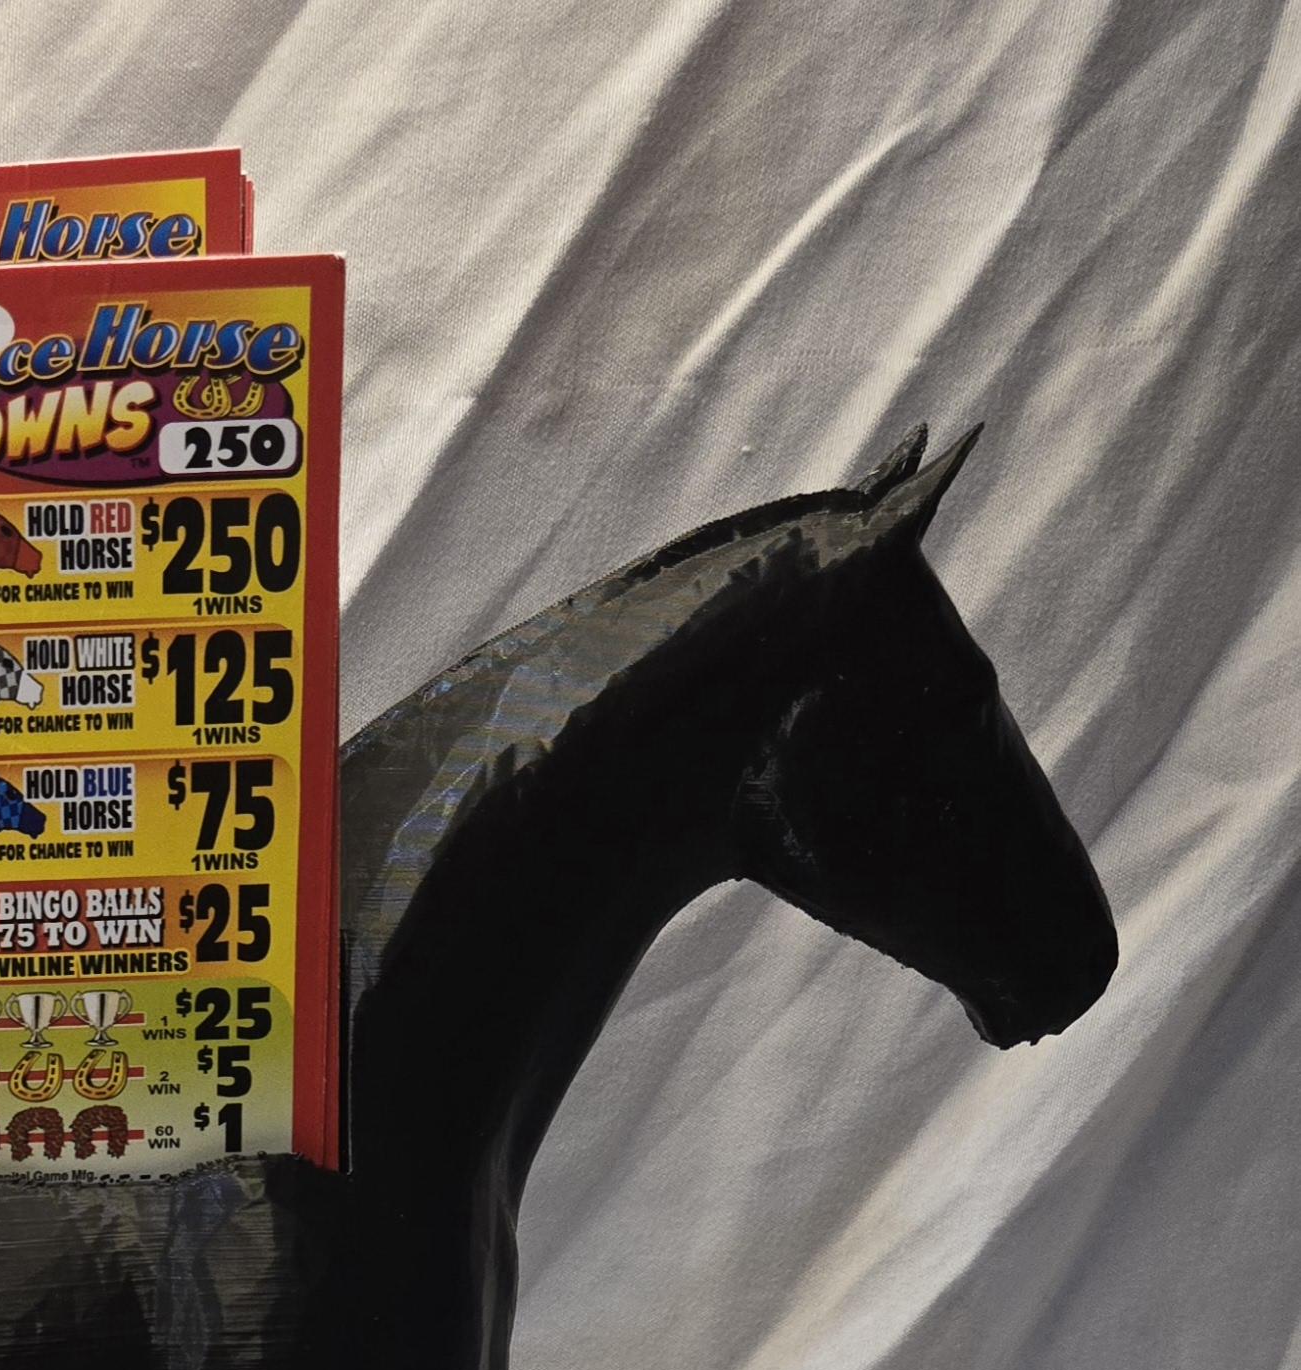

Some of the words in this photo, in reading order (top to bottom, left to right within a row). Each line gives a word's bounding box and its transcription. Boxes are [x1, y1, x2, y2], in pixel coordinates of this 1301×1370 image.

[78, 301, 300, 375] Horse
[185, 424, 286, 468] 250
[27, 505, 85, 537] HOLD
[90, 502, 131, 534] RED
[61, 538, 132, 571] HORSE
[141, 494, 301, 595] $250
[25, 584, 79, 602] CHANCE
[84, 583, 100, 599] TO
[106, 581, 133, 598] WIN
[26, 639, 70, 670] HOLD
[78, 636, 133, 667] WHITE
[62, 674, 132, 706] HORSE
[141, 629, 294, 726] $125
[27, 715, 81, 732] CHANCE
[85, 714, 101, 730] TO
[107, 712, 133, 729] WIN
[26, 770, 78, 799] HOLD
[83, 768, 132, 797] BLUE
[63, 800, 132, 831] HORSE
[168, 759, 275, 851] $75
[30, 842, 82, 860] CHANCE
[87, 842, 103, 858] TO
[107, 840, 133, 857] WIN
[86, 887, 163, 918] BALLS
[44, 922, 87, 947] TO
[95, 919, 163, 945] WIN
[179, 884, 271, 963] $25
[80, 951, 188, 975] WINNERS
[161, 1016, 168, 1026] 1
[176, 987, 272, 1040] $25
[142, 1029, 187, 1040] WINS
[160, 1071, 169, 1081] 2
[197, 1045, 252, 1097] $5
[148, 1084, 181, 1095] WIN
[155, 1126, 173, 1136] 60
[194, 1102, 242, 1152] $1
[148, 1138, 180, 1149] WIN
[33, 1171, 68, 1181] Game
